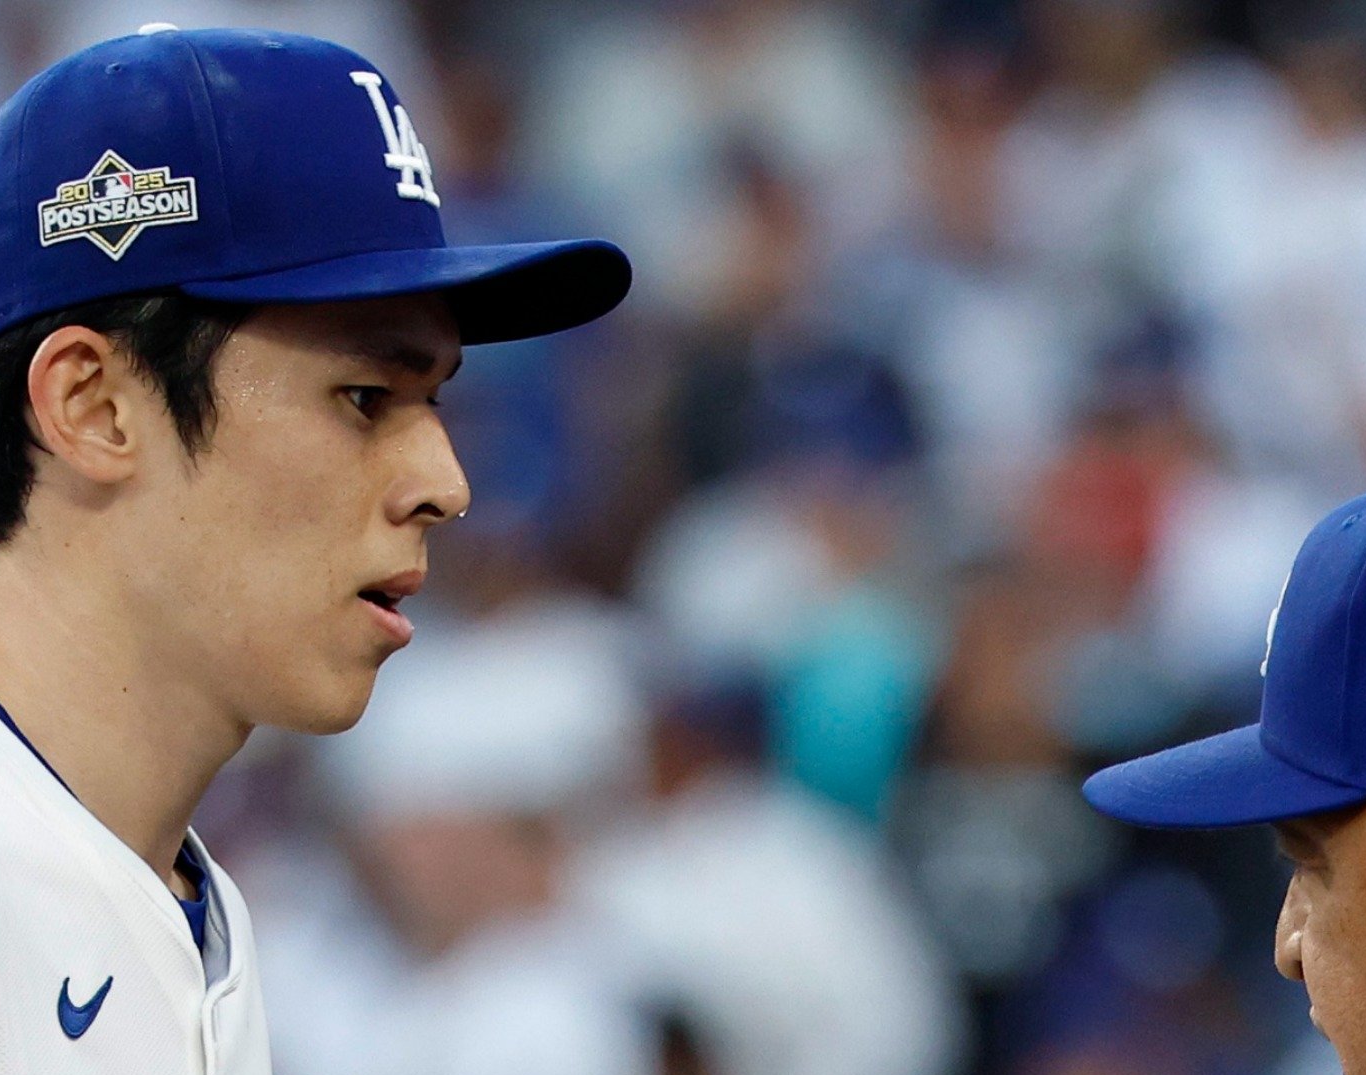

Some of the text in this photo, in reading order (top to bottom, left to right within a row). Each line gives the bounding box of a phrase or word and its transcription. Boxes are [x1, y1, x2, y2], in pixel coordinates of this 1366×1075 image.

[348, 71, 442, 209] LA
[60, 172, 165, 202] 20 25
[42, 189, 191, 234] POSTSEASON
